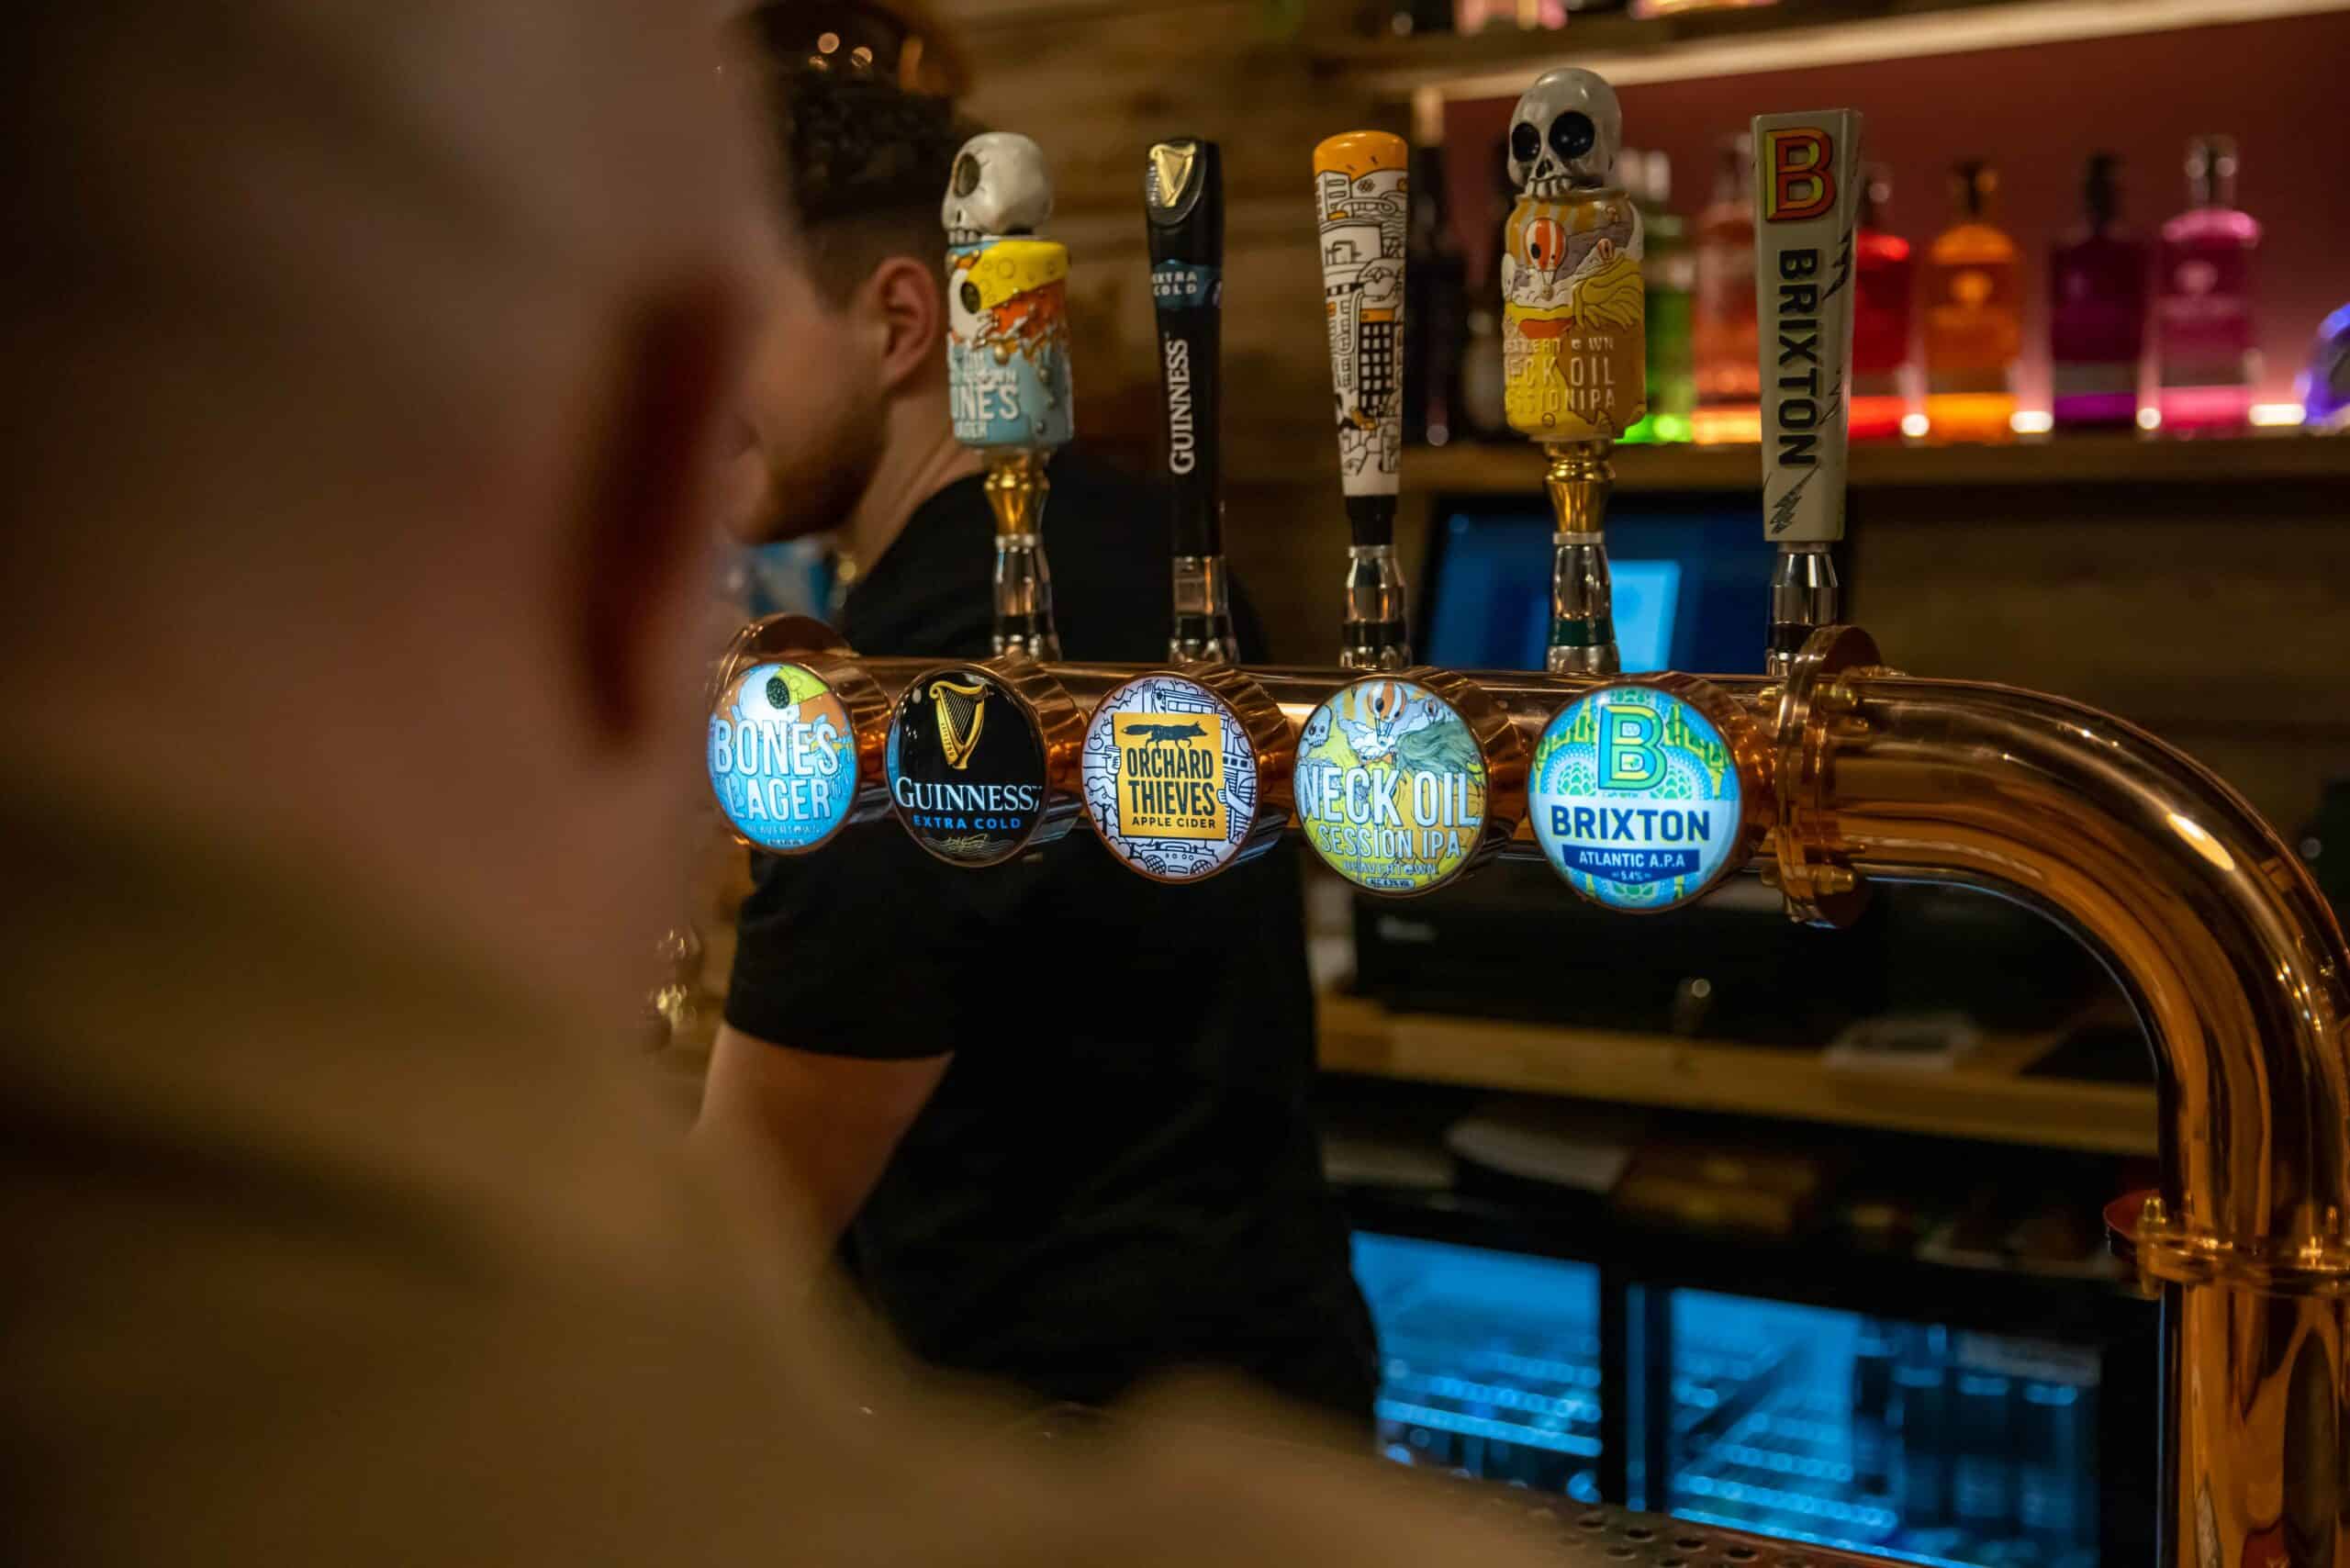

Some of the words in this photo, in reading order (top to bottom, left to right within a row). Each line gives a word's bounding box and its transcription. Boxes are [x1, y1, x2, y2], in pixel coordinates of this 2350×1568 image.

[1764, 127, 1837, 222] B
[1153, 284, 1197, 297] COLD
[1504, 356, 1559, 386] ECK
[1570, 356, 1617, 386] OIL
[1778, 248, 1818, 468] BRIXTON
[1167, 338, 1195, 476] GUINNESS
[1579, 387, 1617, 412] IPA
[713, 719, 839, 777] BONES
[1125, 747, 1214, 779] ORCHARD
[1597, 704, 1668, 791] B
[725, 777, 832, 822] LAGER
[895, 776, 1035, 812] GUINNESS
[1127, 780, 1216, 817] THIEVES
[1298, 765, 1404, 827] NECK
[1412, 769, 1483, 828] OIL
[912, 814, 968, 830] EXTRA
[973, 817, 1022, 830] COLD
[1131, 816, 1172, 828] APPLE
[1176, 817, 1216, 829] CIDER
[1550, 804, 1710, 842] BRIXTON
[1317, 823, 1414, 860] SESSION
[1423, 829, 1462, 860] IPA
[1579, 850, 1645, 868] ATLANTIC
